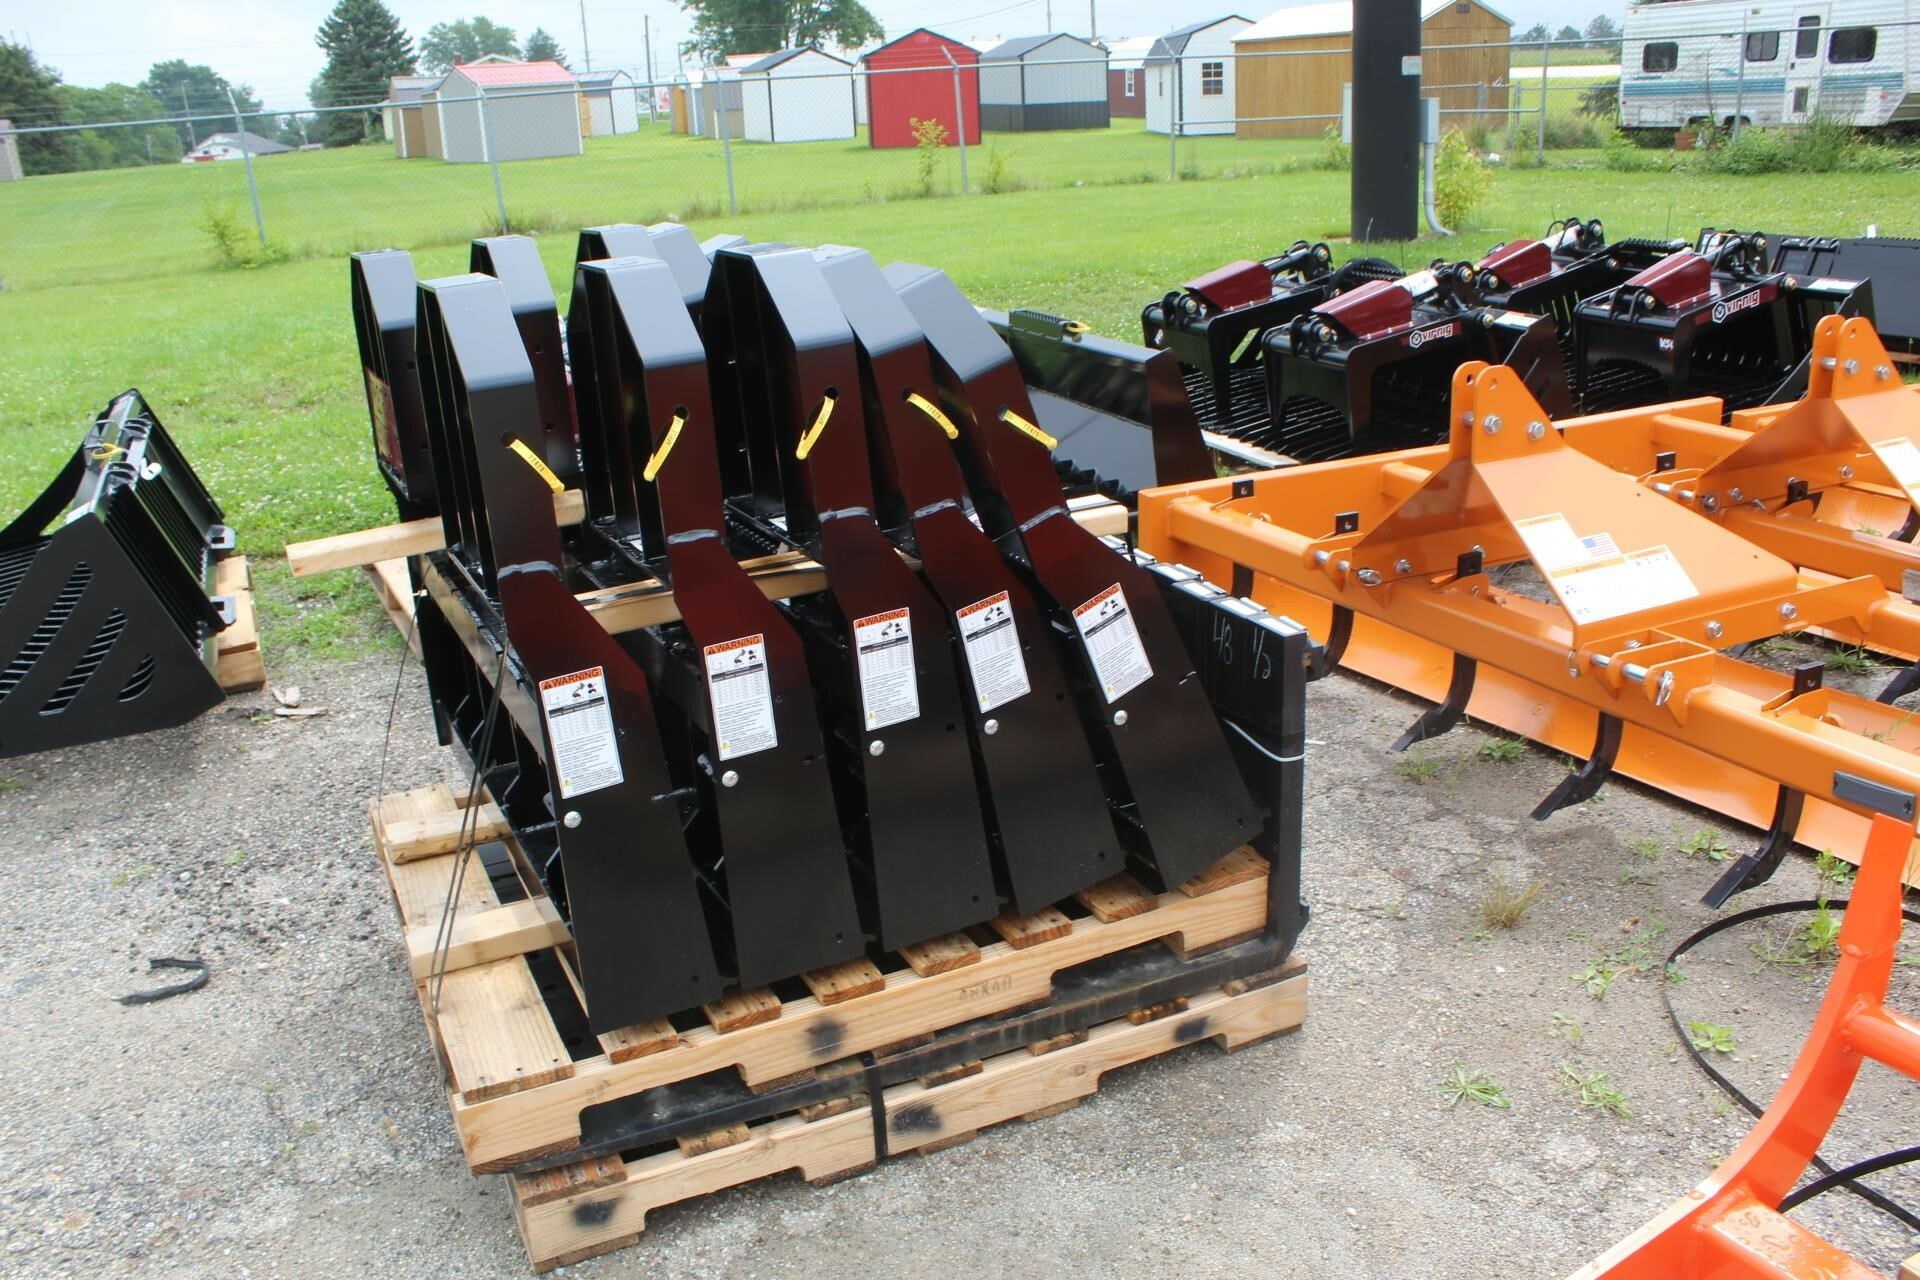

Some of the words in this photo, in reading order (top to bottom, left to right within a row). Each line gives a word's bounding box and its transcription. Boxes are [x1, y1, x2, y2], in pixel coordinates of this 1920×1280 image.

[966, 593, 1006, 614] WARNING
[865, 609, 906, 626] WARNING
[716, 635, 760, 653] WARNING
[1213, 610, 1233, 665] 48
[553, 668, 600, 687] WARNING
